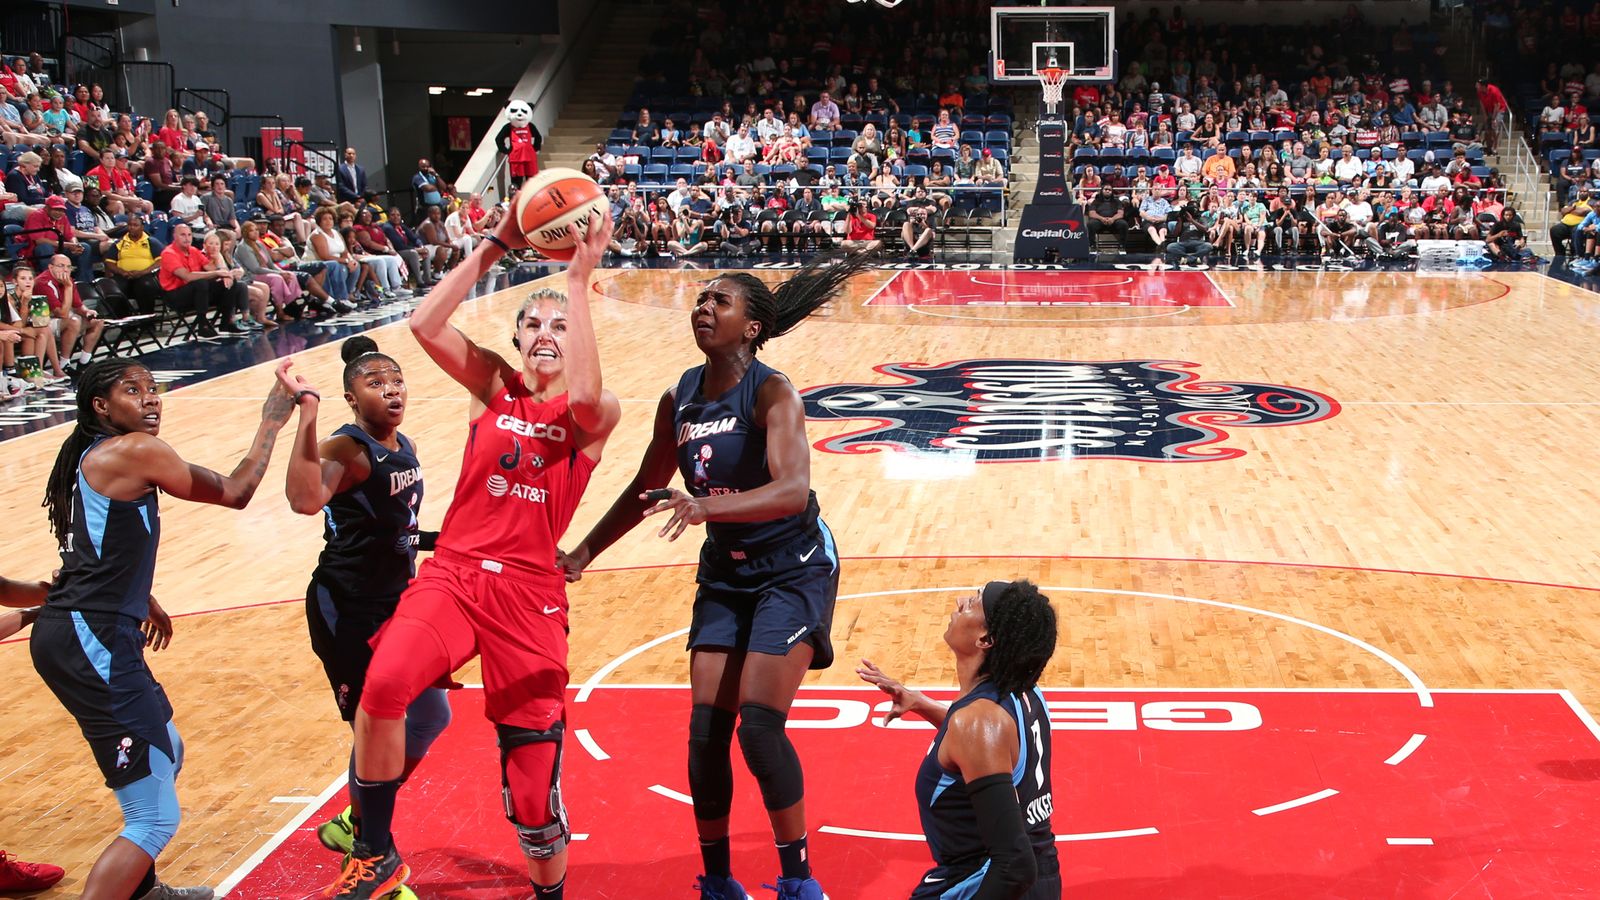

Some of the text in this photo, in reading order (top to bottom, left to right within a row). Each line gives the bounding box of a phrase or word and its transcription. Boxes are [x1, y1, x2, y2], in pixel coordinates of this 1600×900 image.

[540, 204, 601, 243] SALDING
[1108, 368, 1160, 446] WASHINGTON
[496, 413, 567, 442] GEICO
[677, 417, 737, 447] DREAM
[509, 482, 549, 503] AT&T
[784, 698, 1263, 732] GECO
[1026, 792, 1053, 825] SYKES
